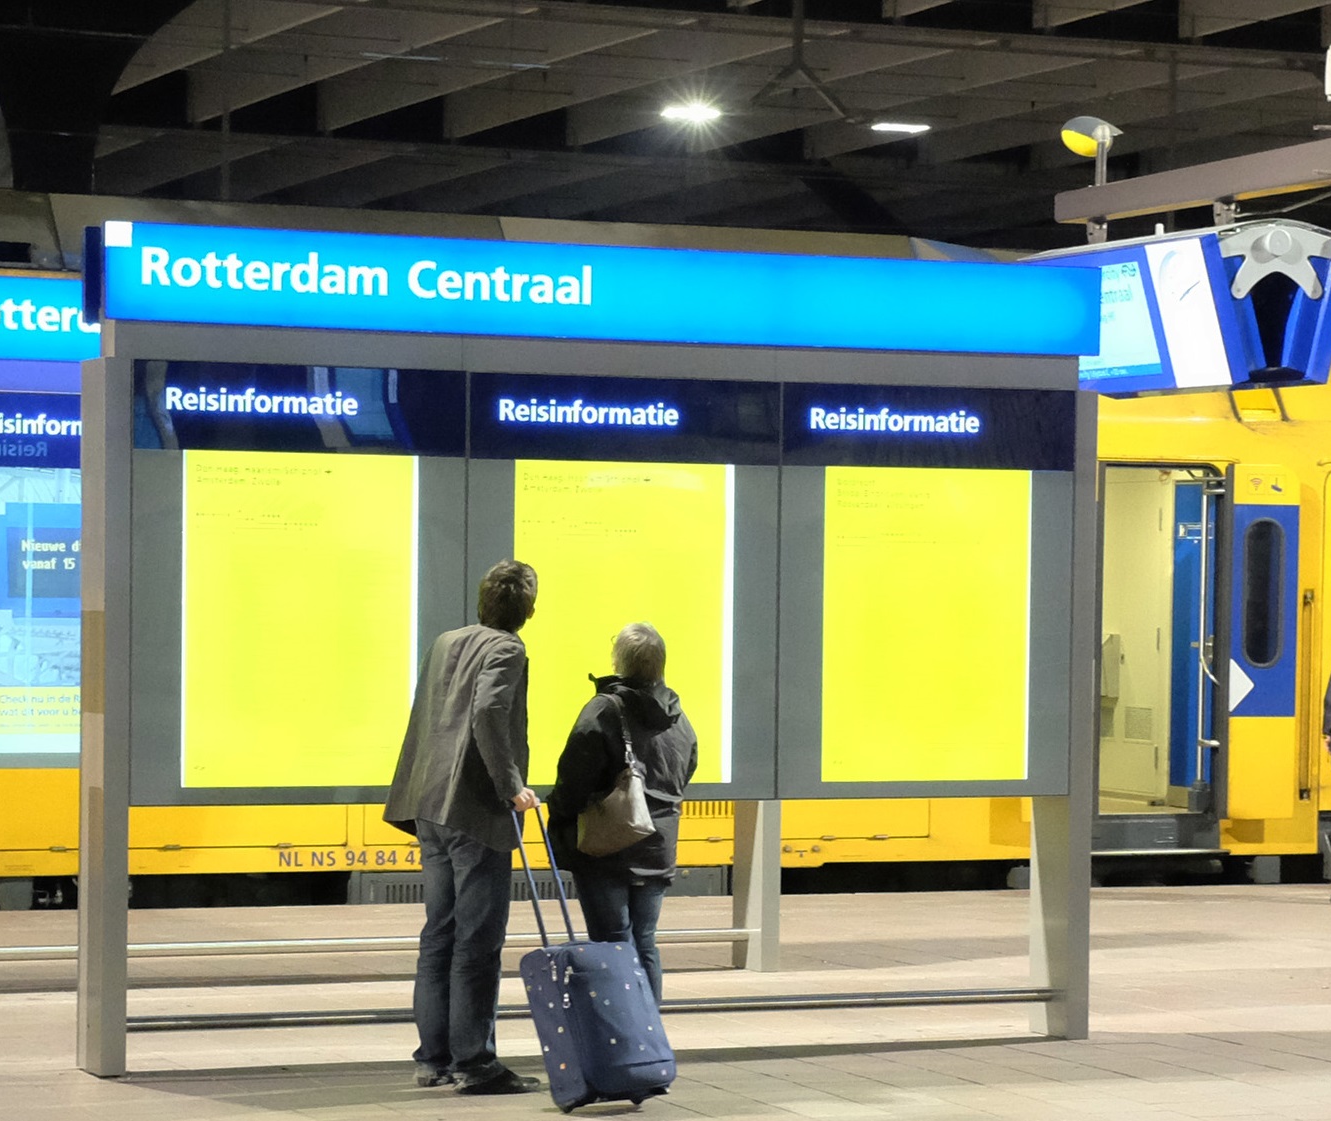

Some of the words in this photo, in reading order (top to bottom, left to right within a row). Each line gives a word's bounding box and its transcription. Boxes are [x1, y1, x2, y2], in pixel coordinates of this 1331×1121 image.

[141, 246, 389, 297] Rotterdam
[408, 260, 593, 306] Centraal
[165, 386, 359, 417] Reisinformatie
[499, 398, 680, 426] Reisinformatie
[809, 406, 980, 434] Reisinformatie
[22, 557, 58, 570] vanaf
[63, 557, 76, 570] 15
[278, 851, 303, 867] NL
[311, 851, 337, 867] NS
[345, 850, 368, 866] 94
[375, 850, 398, 866] 84
